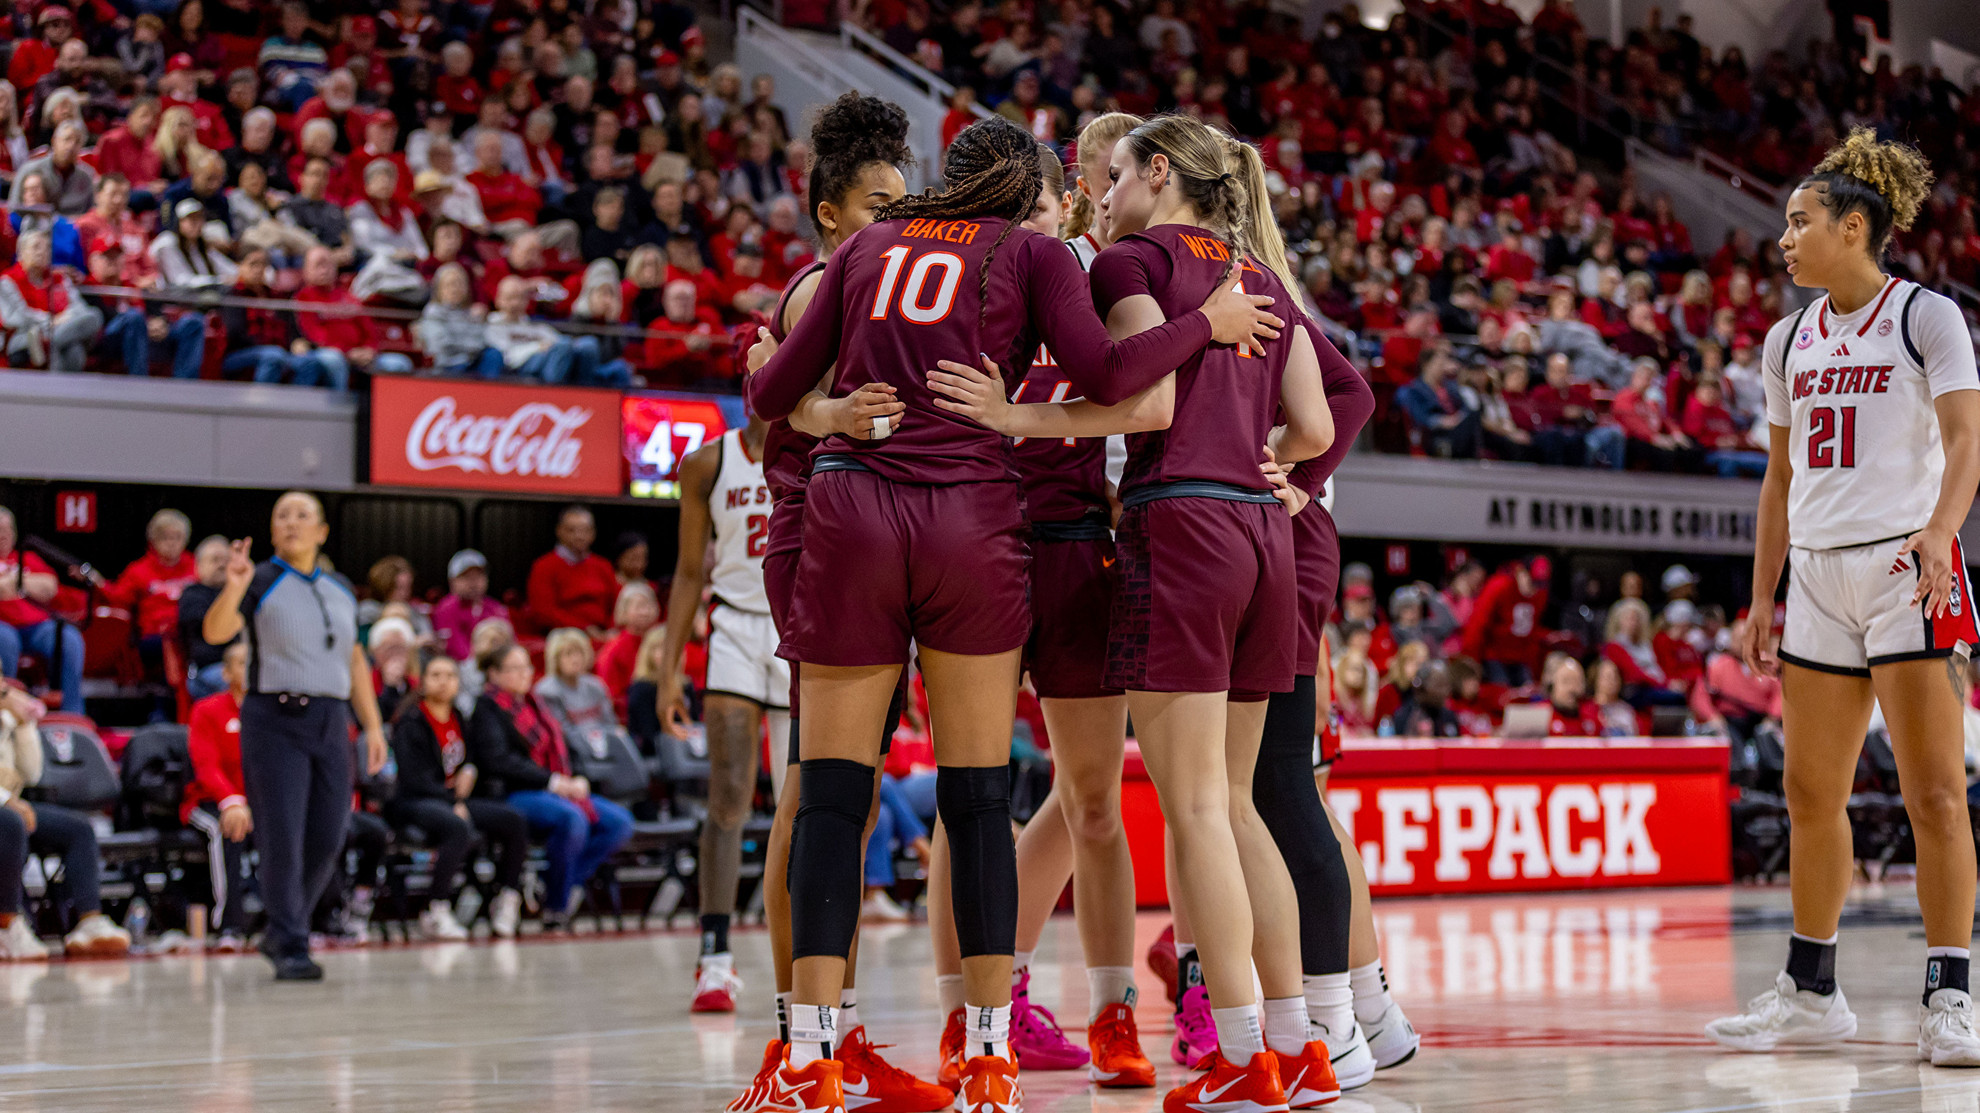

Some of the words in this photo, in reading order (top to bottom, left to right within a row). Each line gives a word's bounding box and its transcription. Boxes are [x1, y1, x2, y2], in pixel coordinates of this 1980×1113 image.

[900, 218, 981, 245] BAKER
[869, 244, 966, 326] 10
[1792, 369, 1818, 401] NC
[1818, 365, 1895, 394] STATE
[640, 420, 706, 475] 47
[1808, 405, 1856, 469] 21
[64, 495, 89, 527] H
[726, 487, 750, 511] NC
[1488, 499, 1517, 528] AT
